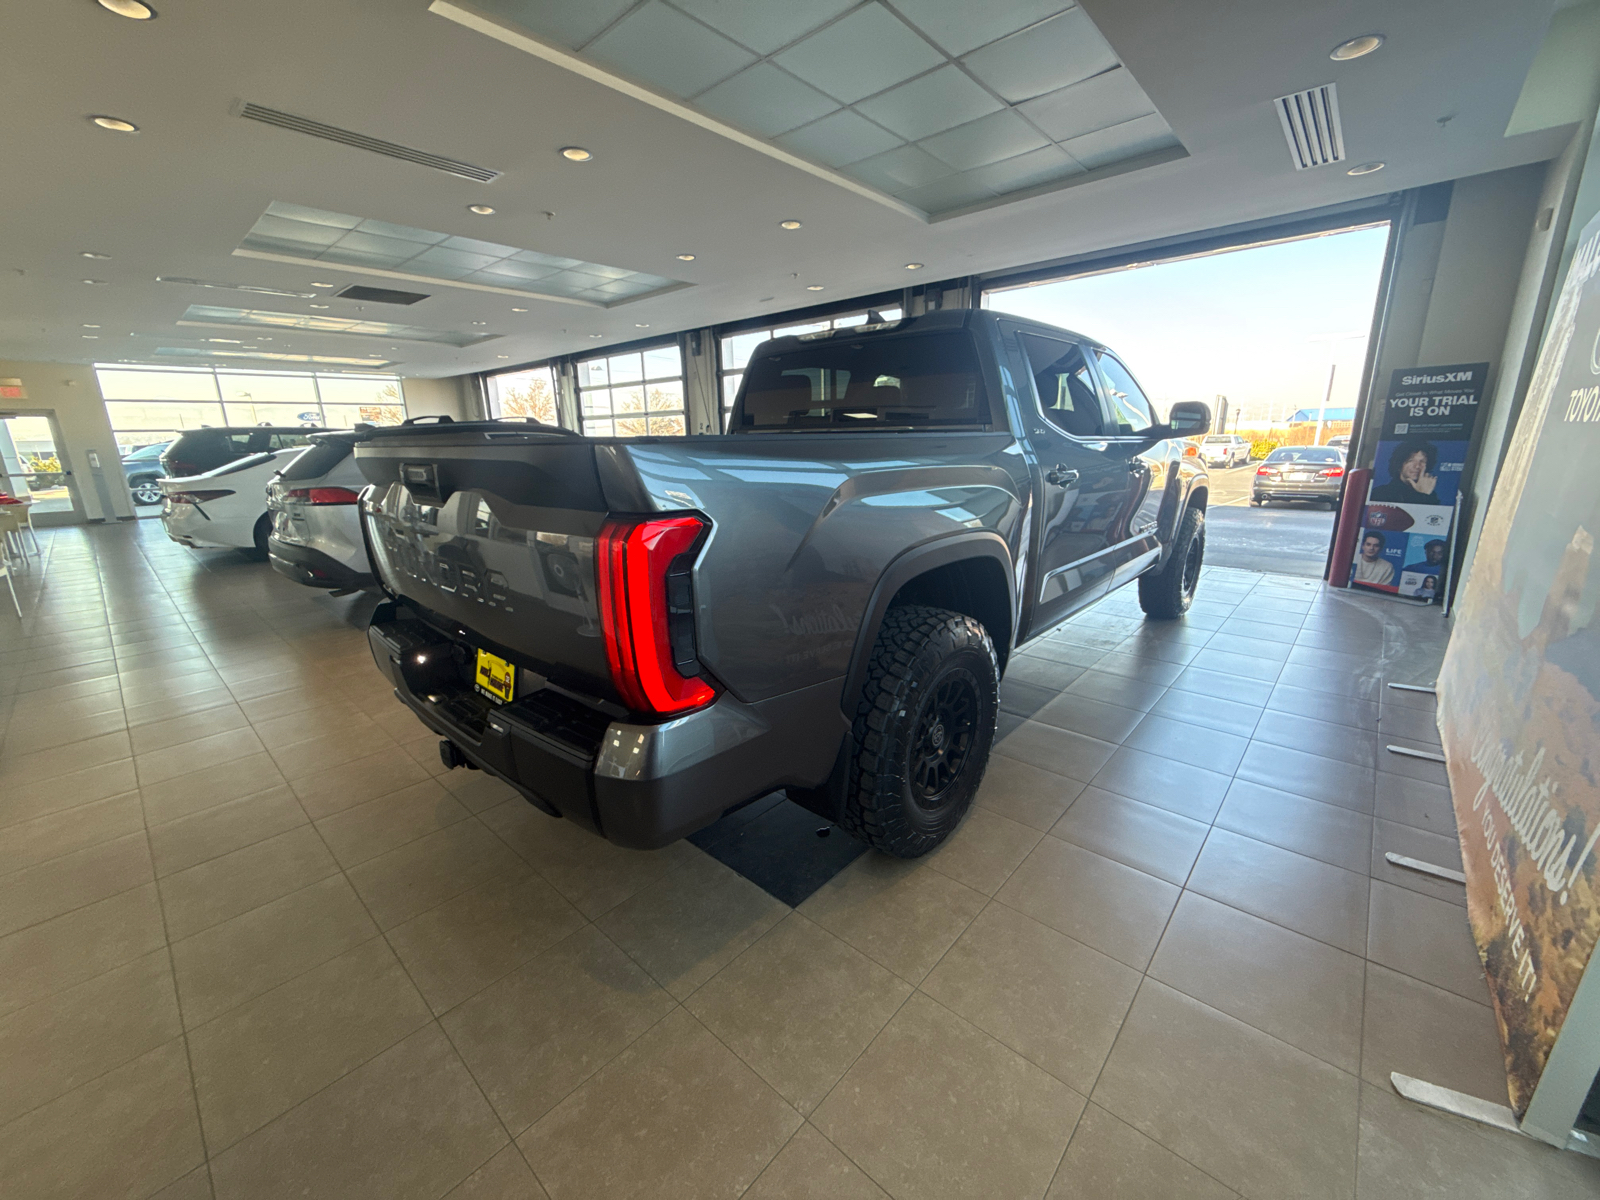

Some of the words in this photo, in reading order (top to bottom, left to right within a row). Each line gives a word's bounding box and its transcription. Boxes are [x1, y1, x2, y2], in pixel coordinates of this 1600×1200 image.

[1402, 371, 1473, 386] SiriusXM
[1390, 398, 1429, 408] YOUR
[1432, 395, 1478, 406] TRIAL
[1564, 386, 1600, 422] TOYO
[1409, 407, 1424, 417] IS
[1427, 406, 1451, 416] ON
[1482, 802, 1497, 850] YOU
[1491, 841, 1525, 960] DESERVE
[1518, 948, 1537, 1003] IT!
